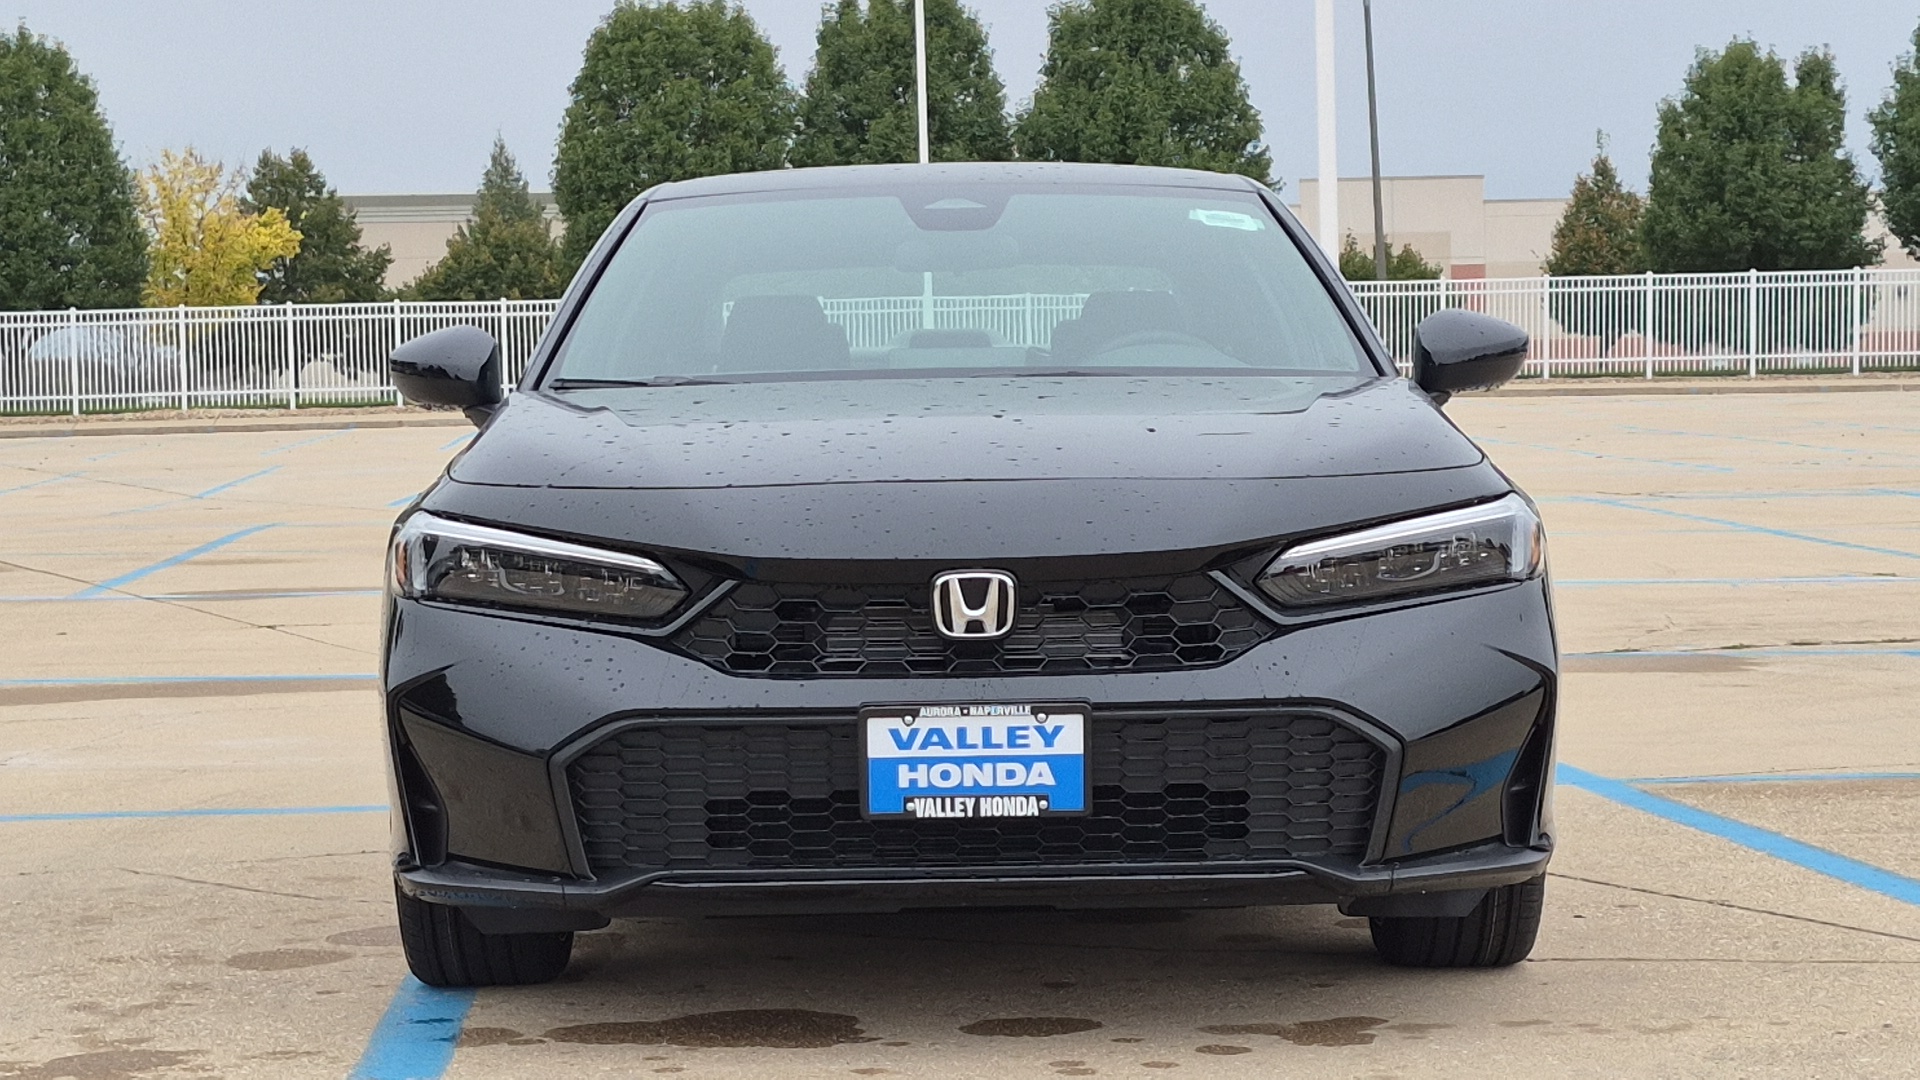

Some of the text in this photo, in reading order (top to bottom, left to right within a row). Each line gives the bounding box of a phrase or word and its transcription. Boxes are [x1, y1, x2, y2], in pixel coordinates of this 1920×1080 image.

[920, 706, 1031, 717] AURORA NAPERVILLE
[888, 725, 1064, 750] VALLEY
[898, 762, 1056, 788] HONDA
[914, 796, 1039, 818] VALLEY HONDA
